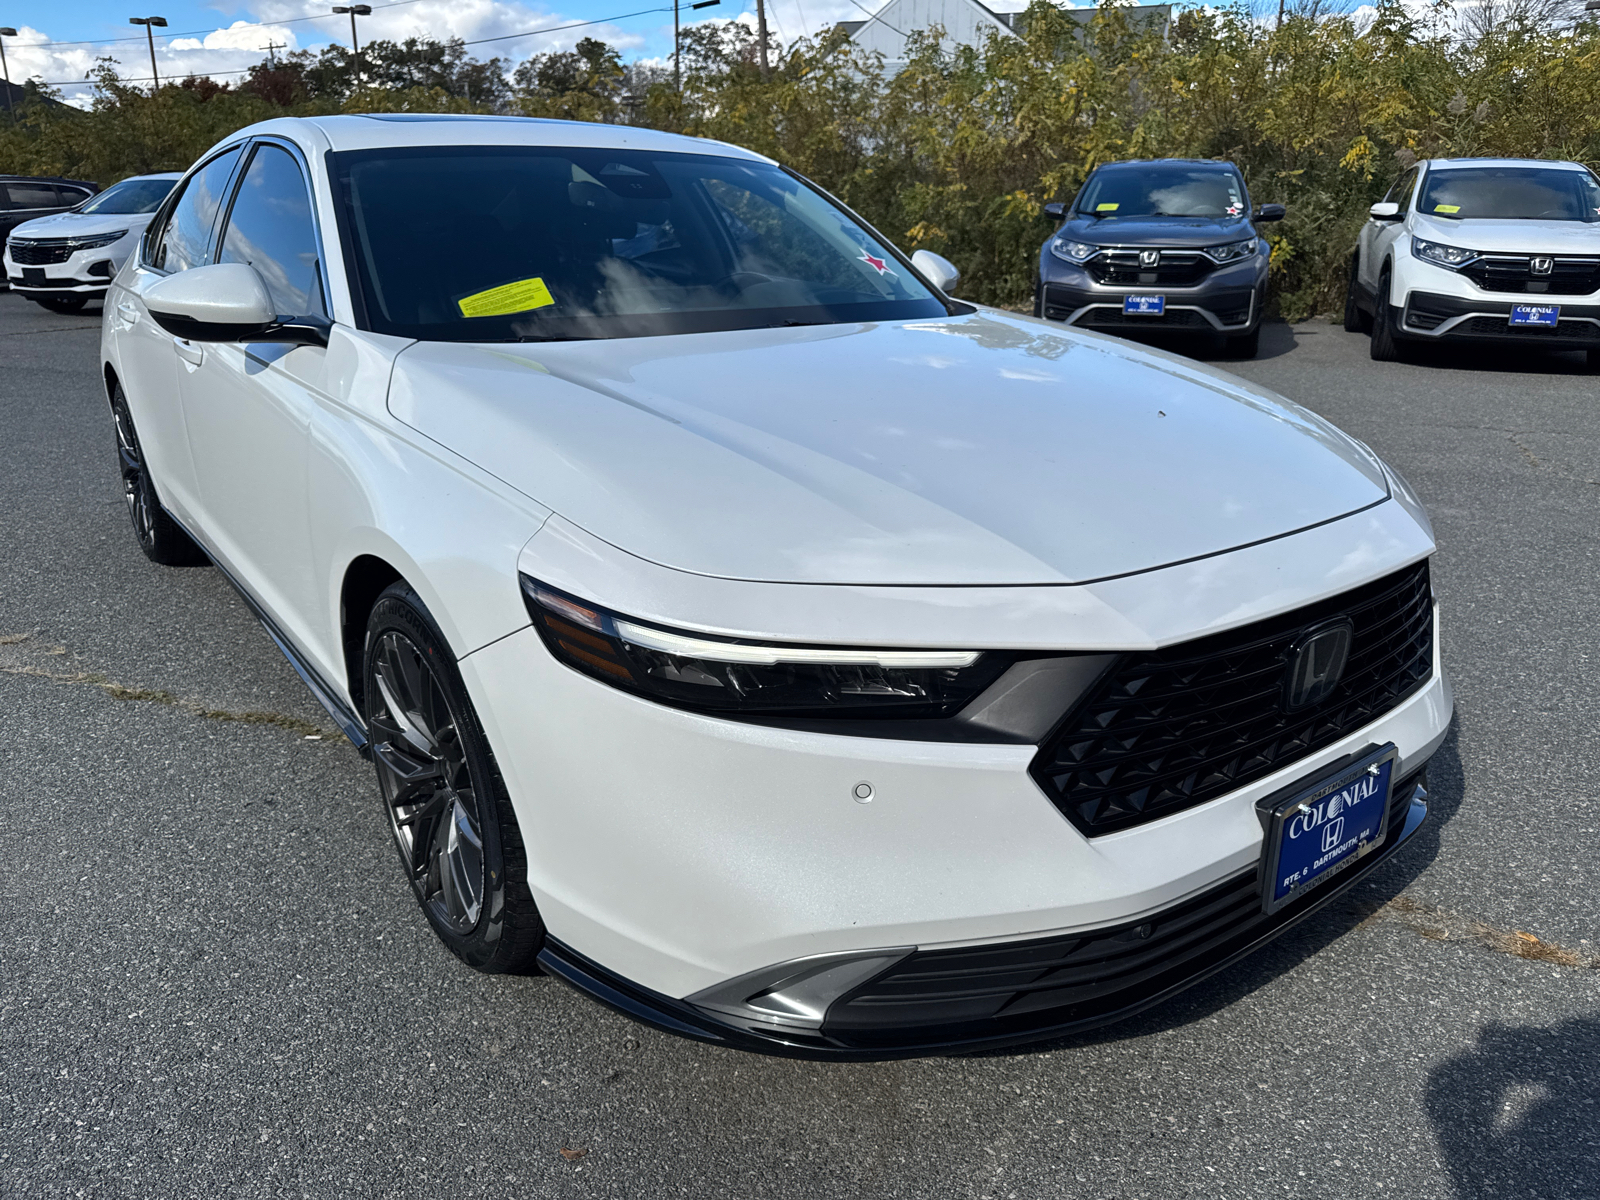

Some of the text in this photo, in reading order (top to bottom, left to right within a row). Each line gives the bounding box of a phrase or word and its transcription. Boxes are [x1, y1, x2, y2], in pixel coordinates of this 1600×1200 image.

[1517, 306, 1554, 314] COLONIAL
[1311, 771, 1358, 801] DARTMOUTH
[1289, 777, 1379, 840] COLONIAL
[1283, 828, 1370, 887] RTE. 6 DARTMOUTH, MA
[1299, 852, 1359, 895] COLONIAL HONDA
